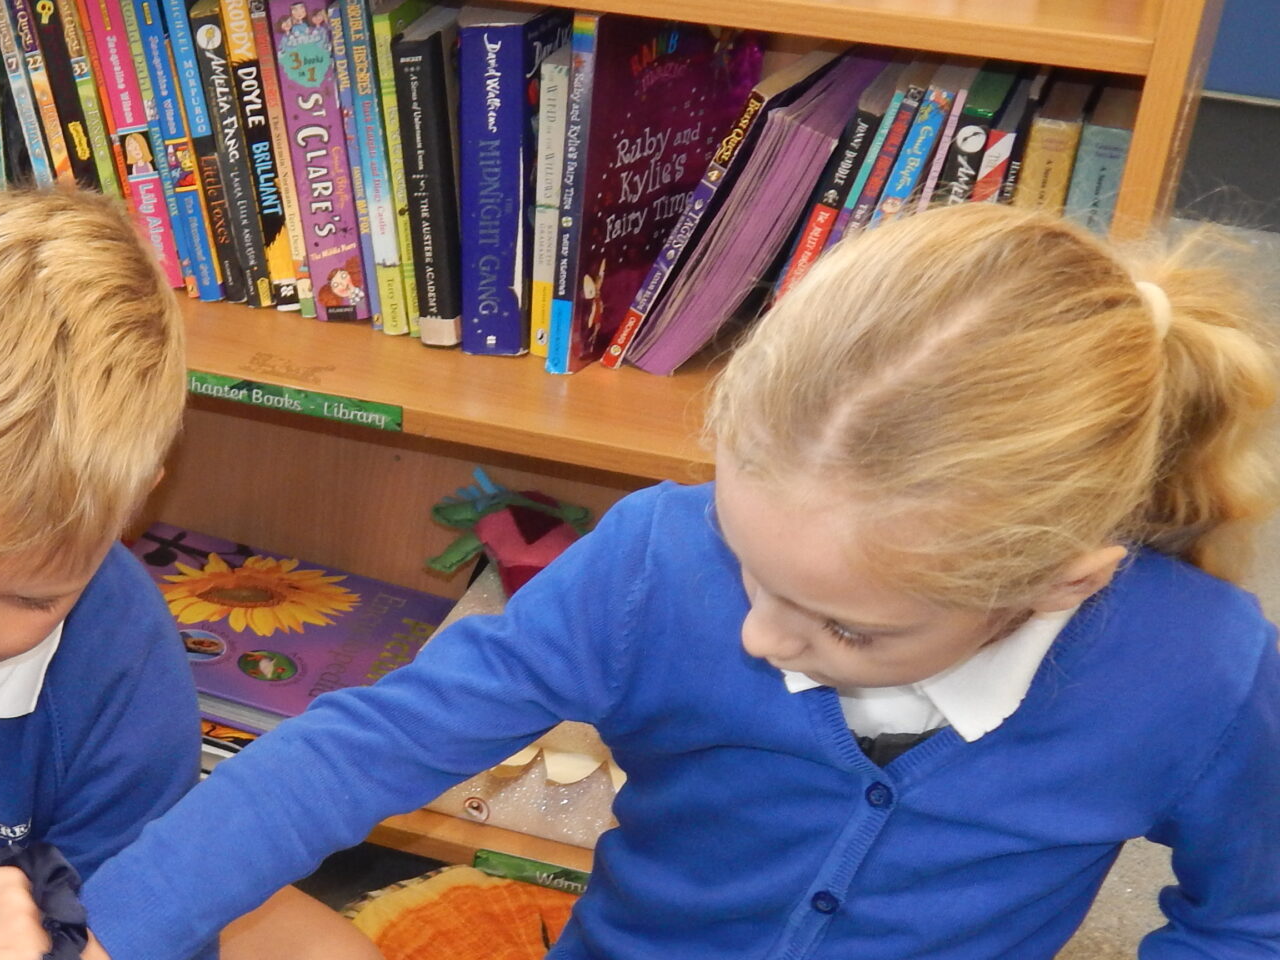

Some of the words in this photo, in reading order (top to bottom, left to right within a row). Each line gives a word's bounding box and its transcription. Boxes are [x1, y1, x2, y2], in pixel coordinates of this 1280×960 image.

[12, 9, 36, 51] Quest
[61, 15, 83, 54] Quest
[224, 0, 254, 60] RODDY
[329, 16, 346, 55] ROALD
[26, 54, 44, 70] 22
[71, 59, 90, 76] 33
[131, 51, 152, 93] Dahl
[288, 51, 302, 70] 3
[352, 44, 373, 96] HISTORIES
[482, 32, 501, 75] David
[102, 34, 126, 90] Jacqueline
[118, 90, 135, 124] Wilson
[147, 34, 170, 96] Jacqueline
[161, 98, 179, 135] Wilson
[205, 47, 236, 113] AMELIA
[306, 66, 317, 82] 1
[335, 59, 351, 91] DAHL
[569, 70, 586, 100] Ruby
[182, 56, 208, 135] MORPURGO
[236, 65, 267, 129] DOYLE
[484, 76, 499, 133] Walliams
[544, 84, 558, 123] WIND
[571, 101, 583, 121] and
[737, 97, 763, 131] Beast
[86, 107, 107, 148] FANG
[219, 114, 245, 164] FANG
[270, 114, 281, 133] The
[363, 123, 377, 159] Knights
[566, 123, 582, 158] Kylie's
[848, 116, 868, 148] JONNY
[908, 120, 934, 156] Enid
[149, 124, 171, 177] FANTASTIC
[273, 135, 288, 170] Stormin'
[615, 127, 671, 169] Ruby
[673, 121, 701, 147] and
[712, 123, 745, 167] Quest
[198, 152, 223, 197] Little
[229, 170, 245, 199] LAURA
[249, 139, 282, 218] BRILLIANT
[294, 122, 343, 238] CLARE'S
[368, 159, 380, 177] and
[564, 160, 579, 186] Fairy
[618, 152, 687, 203] Kylie's
[832, 148, 856, 186] DUDDLE
[893, 153, 921, 195] Blyton
[135, 181, 158, 212] Lily
[163, 179, 175, 195] MR
[167, 195, 180, 216] FOX
[183, 195, 196, 215] The
[280, 170, 294, 207] Normans
[351, 165, 363, 197] FANTASTIC
[358, 215, 370, 234] FOX
[563, 187, 576, 210] Time
[209, 197, 233, 244] Foxes
[235, 198, 252, 225] ELLEN
[284, 211, 298, 234] Terry
[374, 203, 389, 236] Castles
[418, 198, 430, 218] THE
[604, 207, 648, 243] Fairy
[187, 215, 206, 262] Diamond
[240, 226, 258, 265] ANDERSON
[289, 235, 302, 257] Deary
[420, 219, 434, 264] AUSTERE
[670, 209, 700, 251] TAGUS
[383, 277, 396, 301] Terry
[422, 264, 439, 315] ACADEMY
[477, 253, 501, 315] GANG
[647, 269, 663, 291] ADAM
[386, 302, 400, 329] Deary
[635, 289, 653, 311] BLADE
[616, 315, 637, 345] ORCHARD
[252, 388, 303, 412] Books
[323, 401, 386, 430] Library
